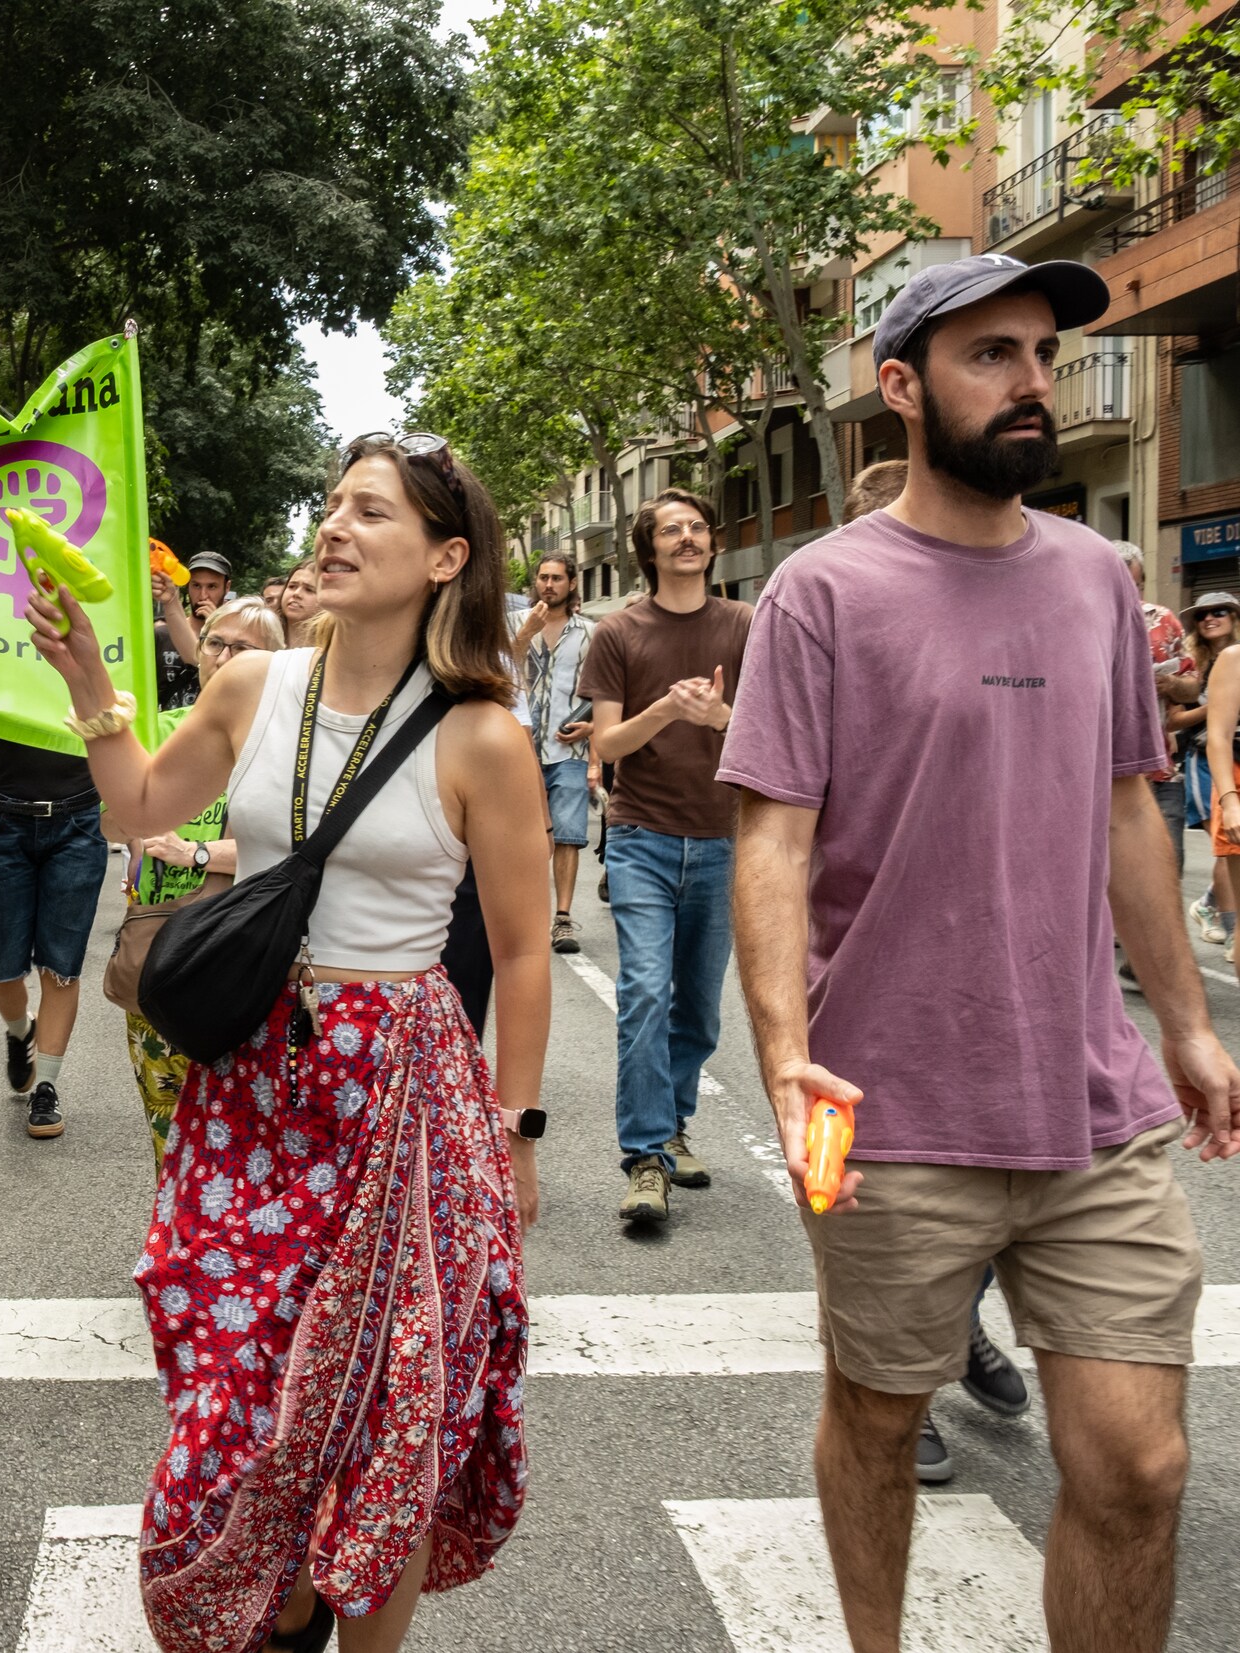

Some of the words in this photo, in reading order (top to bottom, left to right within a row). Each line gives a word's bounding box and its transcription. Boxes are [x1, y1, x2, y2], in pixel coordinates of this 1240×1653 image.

[1193, 526, 1222, 545] VIBE
[1011, 676, 1046, 688] LATER
[305, 691, 317, 720] YOUR
[296, 720, 312, 779] ACCELERATE
[344, 723, 377, 781] ACCELERATE
[294, 814, 304, 841] START
